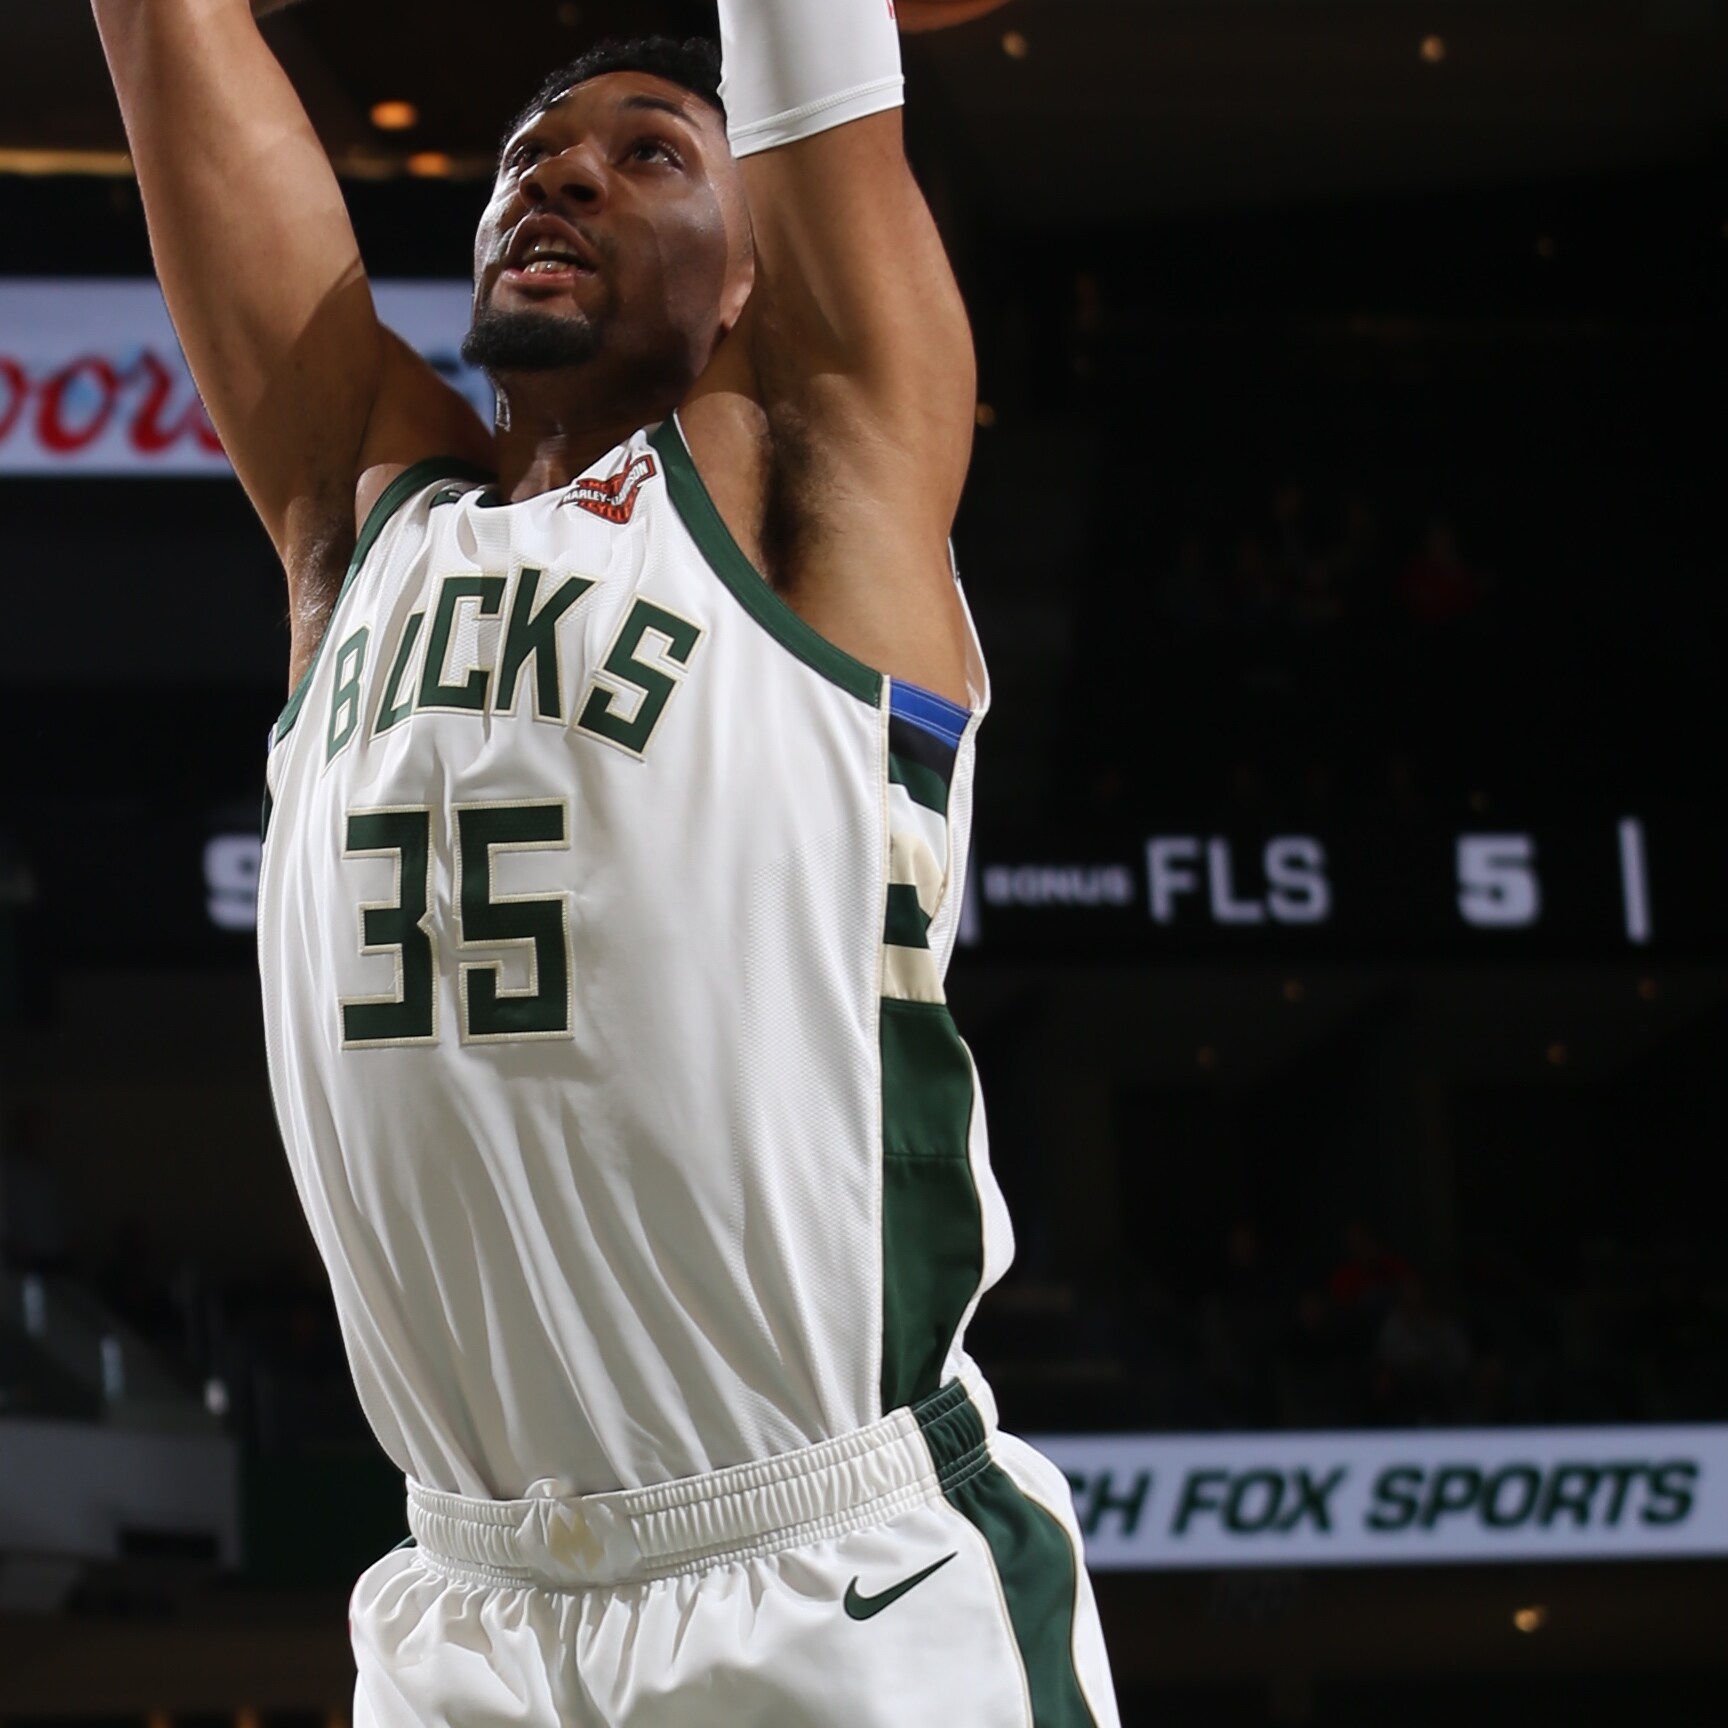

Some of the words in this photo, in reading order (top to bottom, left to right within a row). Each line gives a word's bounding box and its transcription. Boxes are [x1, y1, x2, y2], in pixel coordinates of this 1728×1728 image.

[324, 566, 704, 769] BUCKS
[340, 798, 574, 1049] 35
[984, 866, 1131, 906] BONUS
[1147, 836, 1330, 924] FLS
[1457, 834, 1540, 926] 5
[1172, 1464, 1345, 1538] FOX
[1366, 1459, 1698, 1536] SPORTS
